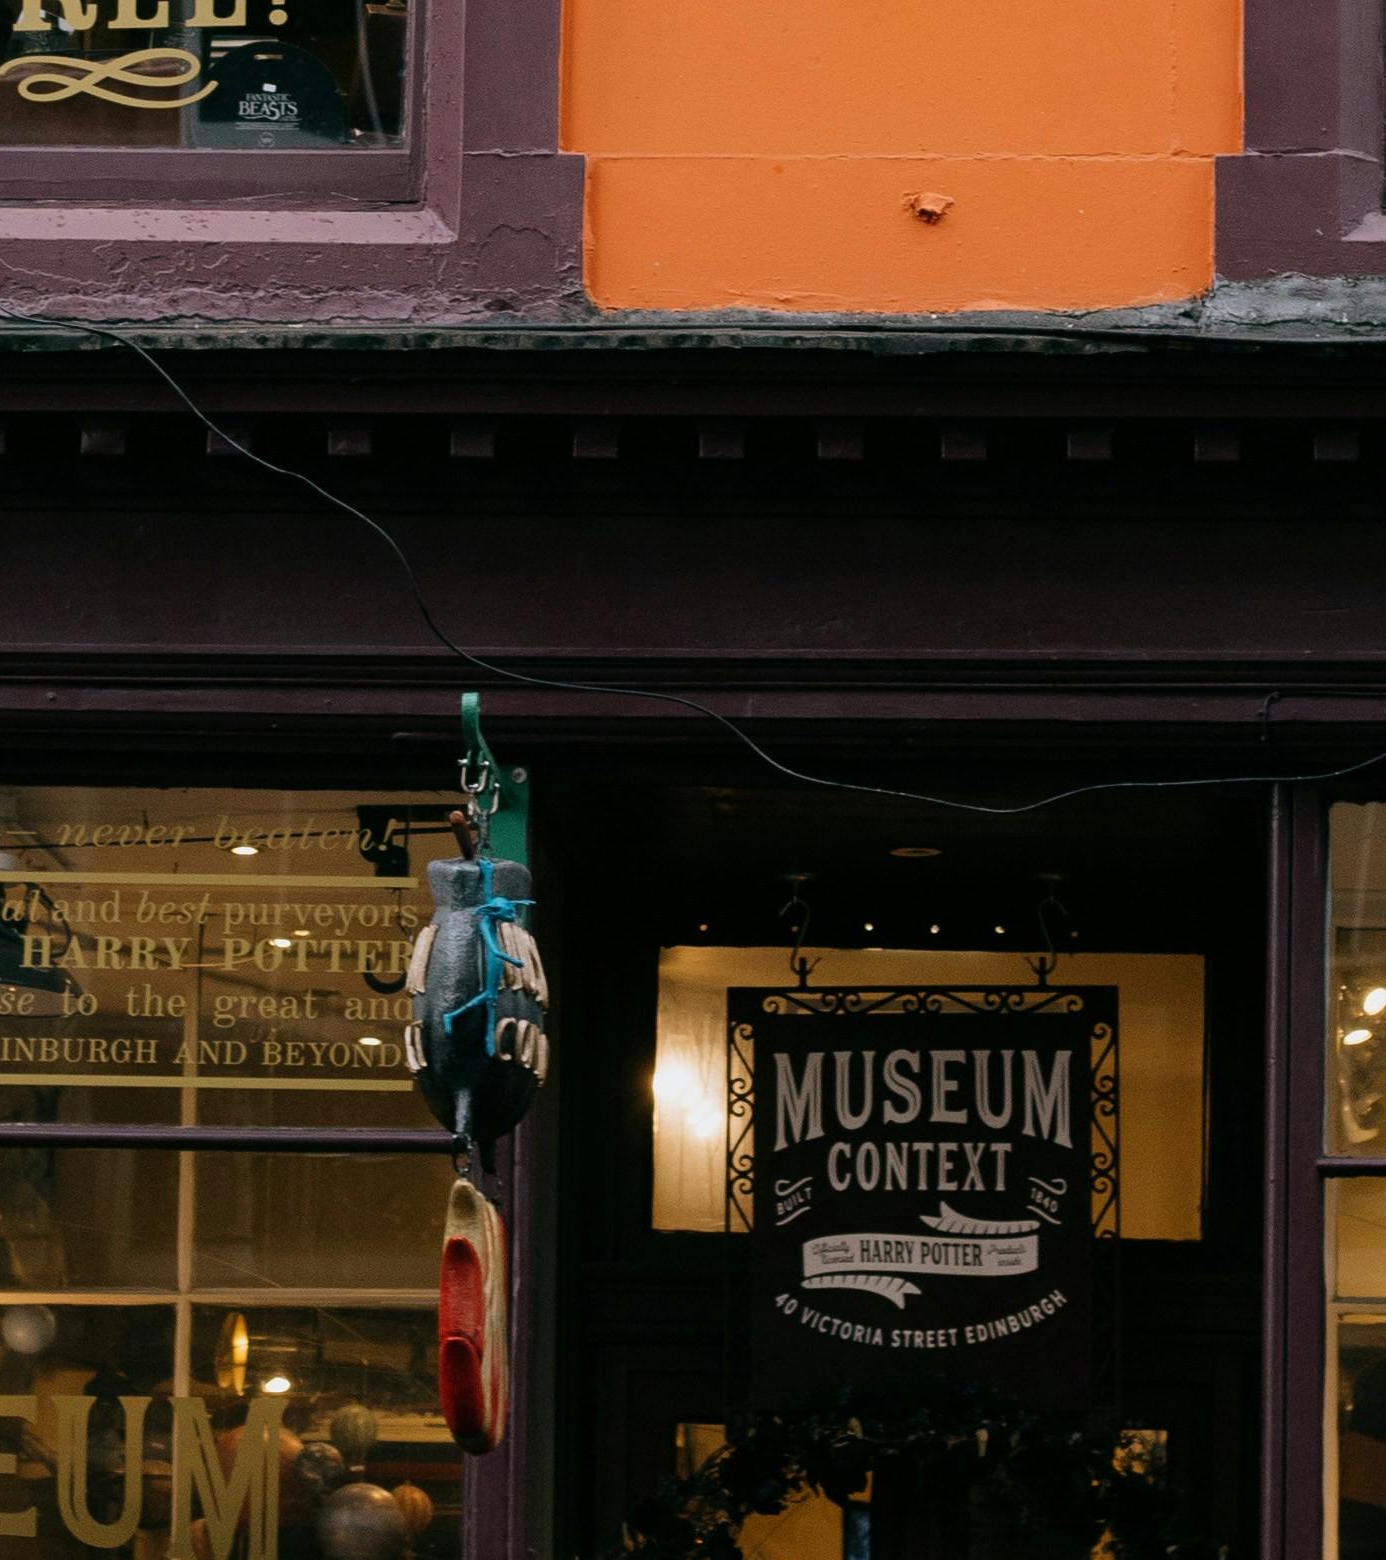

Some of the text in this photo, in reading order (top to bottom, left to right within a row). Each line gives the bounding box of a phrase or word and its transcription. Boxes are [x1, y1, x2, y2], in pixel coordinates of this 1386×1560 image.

[238, 101, 298, 118] BEASTS
[57, 824, 196, 847] never
[214, 816, 397, 851] beaten!
[52, 891, 120, 923] and
[137, 891, 211, 925] best
[223, 900, 419, 937] purveyors
[20, 935, 192, 971] HARRY
[223, 939, 414, 975] POTTER
[62, 991, 98, 1017] to
[127, 984, 186, 1017] the
[213, 993, 317, 1029] great
[343, 990, 414, 1021] and
[173, 1039, 247, 1065] AND
[773, 1049, 1073, 1151] MUSEUM
[828, 1142, 1012, 1192] CONTEXT
[776, 1187, 812, 1215] BUILT
[861, 1239, 914, 1264] HARRY
[921, 1243, 983, 1267] POTTER
[775, 1289, 1067, 1348] 40 VICTORIA STREET EDINBURGH
